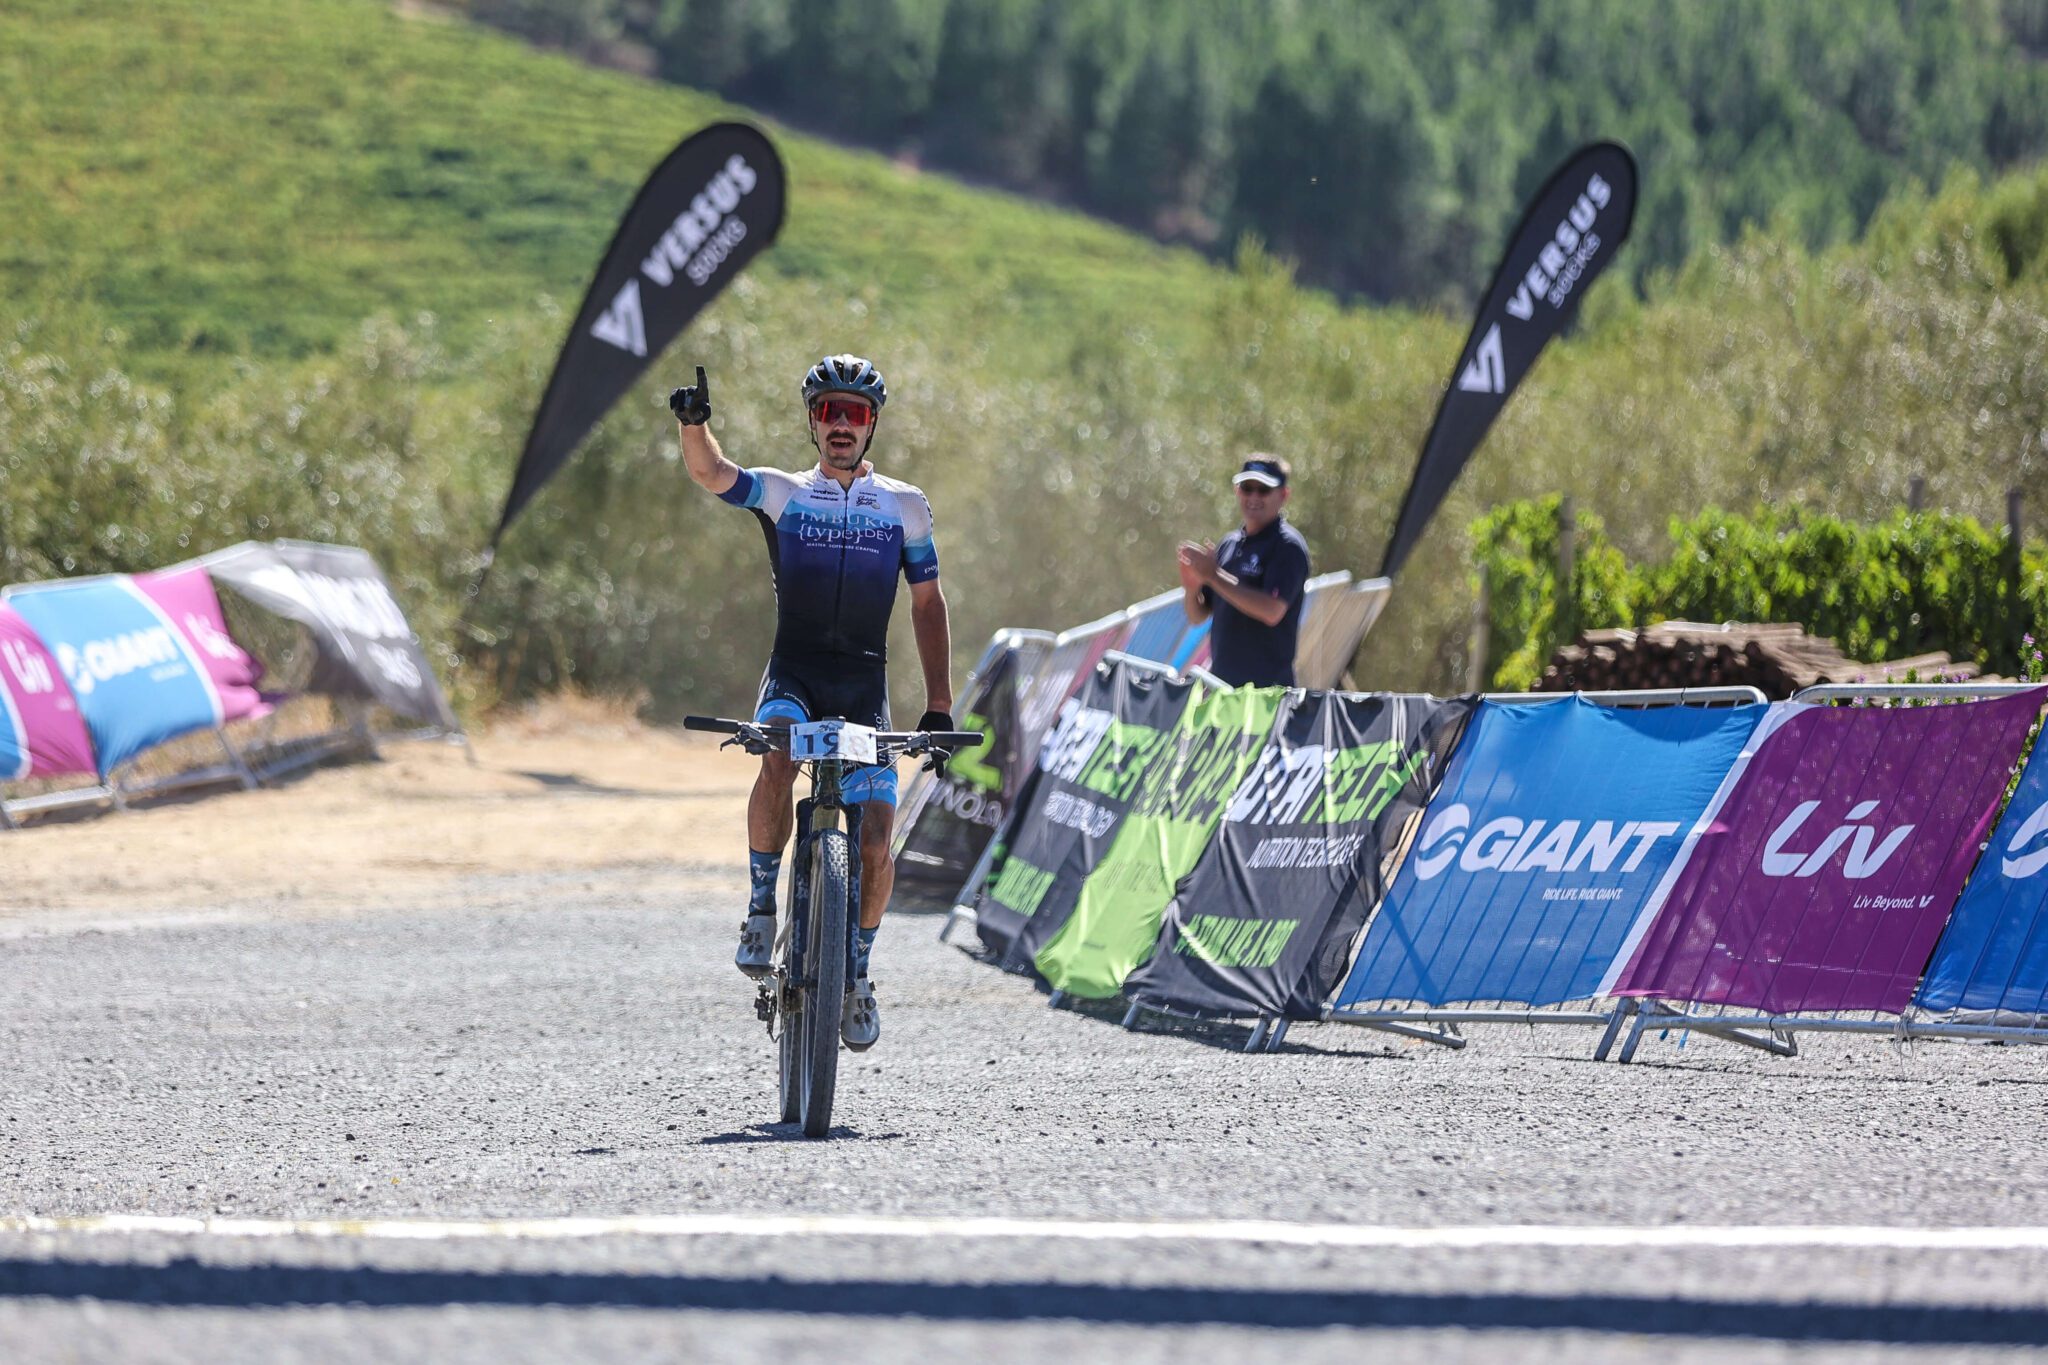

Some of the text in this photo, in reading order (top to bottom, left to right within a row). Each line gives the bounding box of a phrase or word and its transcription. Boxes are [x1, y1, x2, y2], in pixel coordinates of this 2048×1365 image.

[640, 154, 757, 288] VERSUS
[1505, 172, 1611, 321] VERSUS
[800, 510, 893, 530] IMBUKO
[1459, 819, 1681, 874] GIANT
[1542, 887, 1562, 900] RIDE
[1578, 887, 1599, 901] RIDE
[1853, 895, 1916, 911] Liv Beyond.
